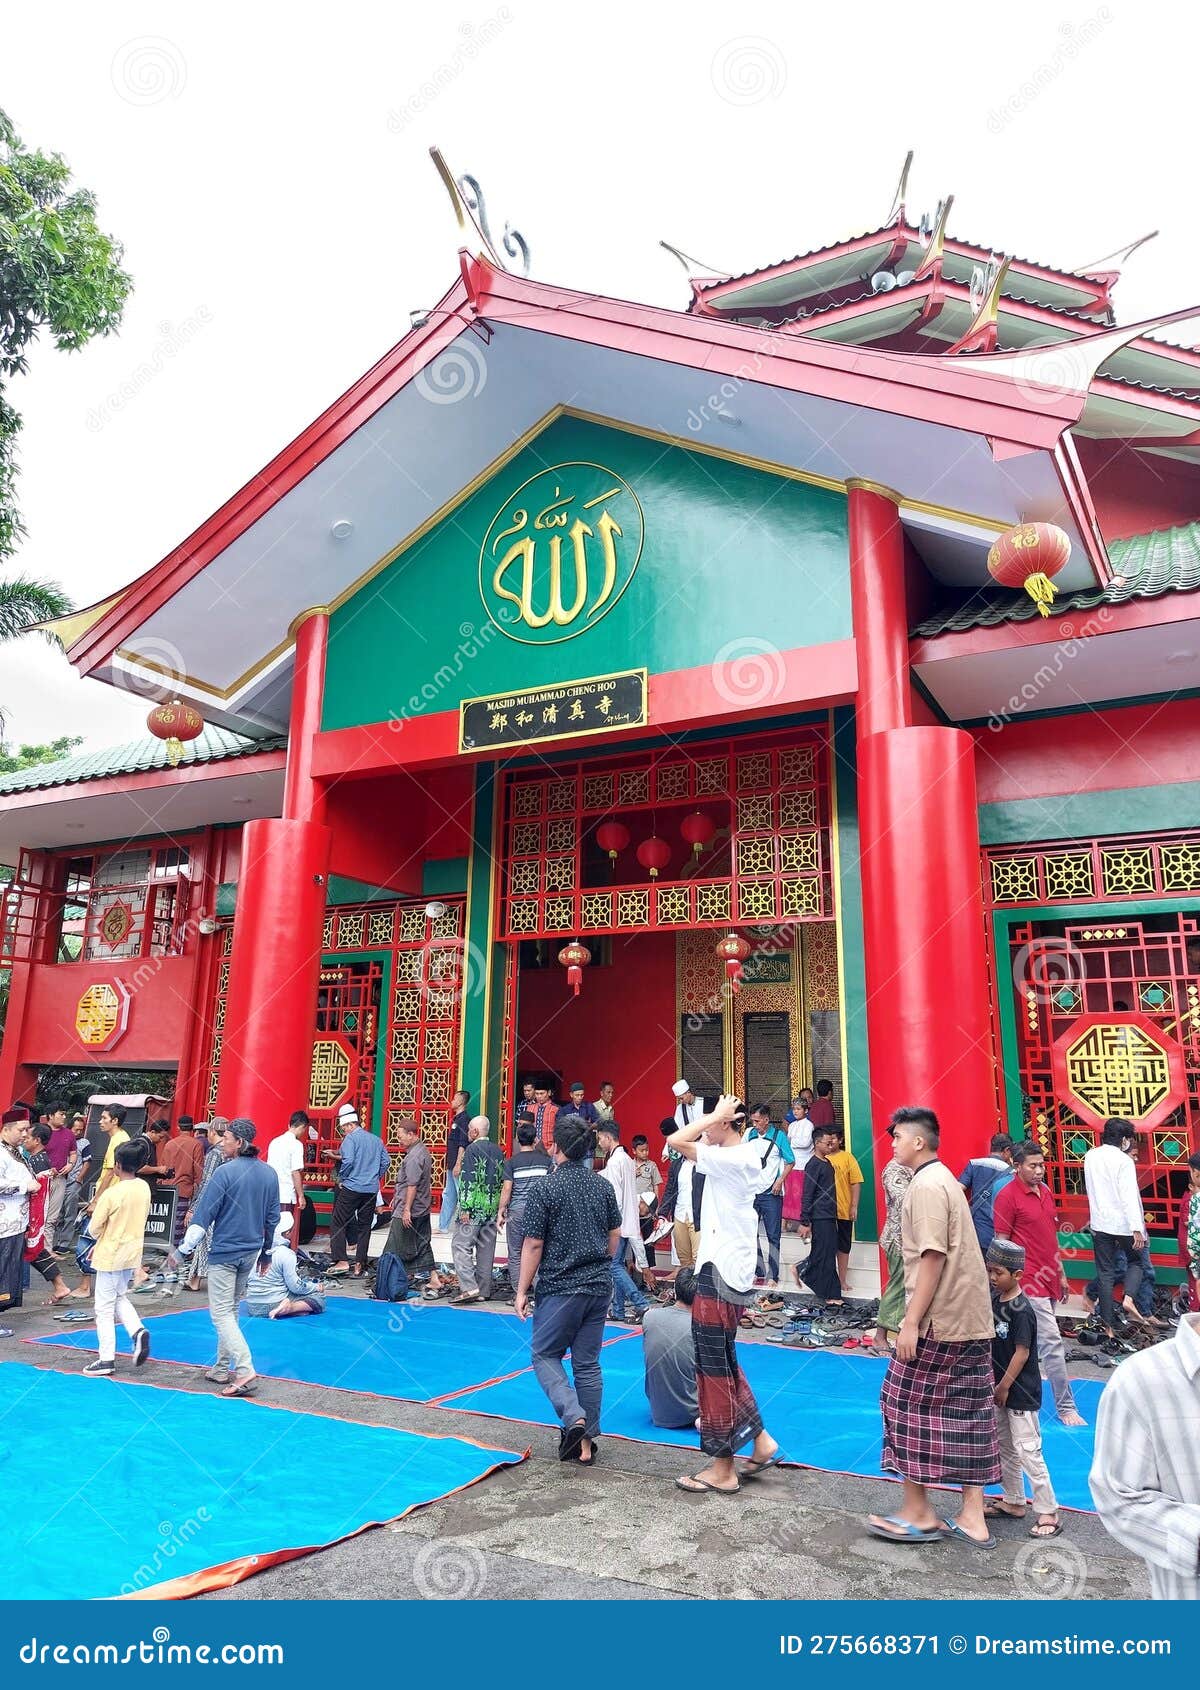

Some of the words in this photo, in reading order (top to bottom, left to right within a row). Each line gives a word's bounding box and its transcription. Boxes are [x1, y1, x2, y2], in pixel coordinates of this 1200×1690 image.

[487, 698, 516, 711] MASJID
[516, 690, 566, 706] MUHAMMAD
[567, 684, 596, 697] CHENG
[597, 681, 616, 692] HOO
[489, 695, 613, 733] 郑和清真寺
[144, 1220, 165, 1233] ASJID
